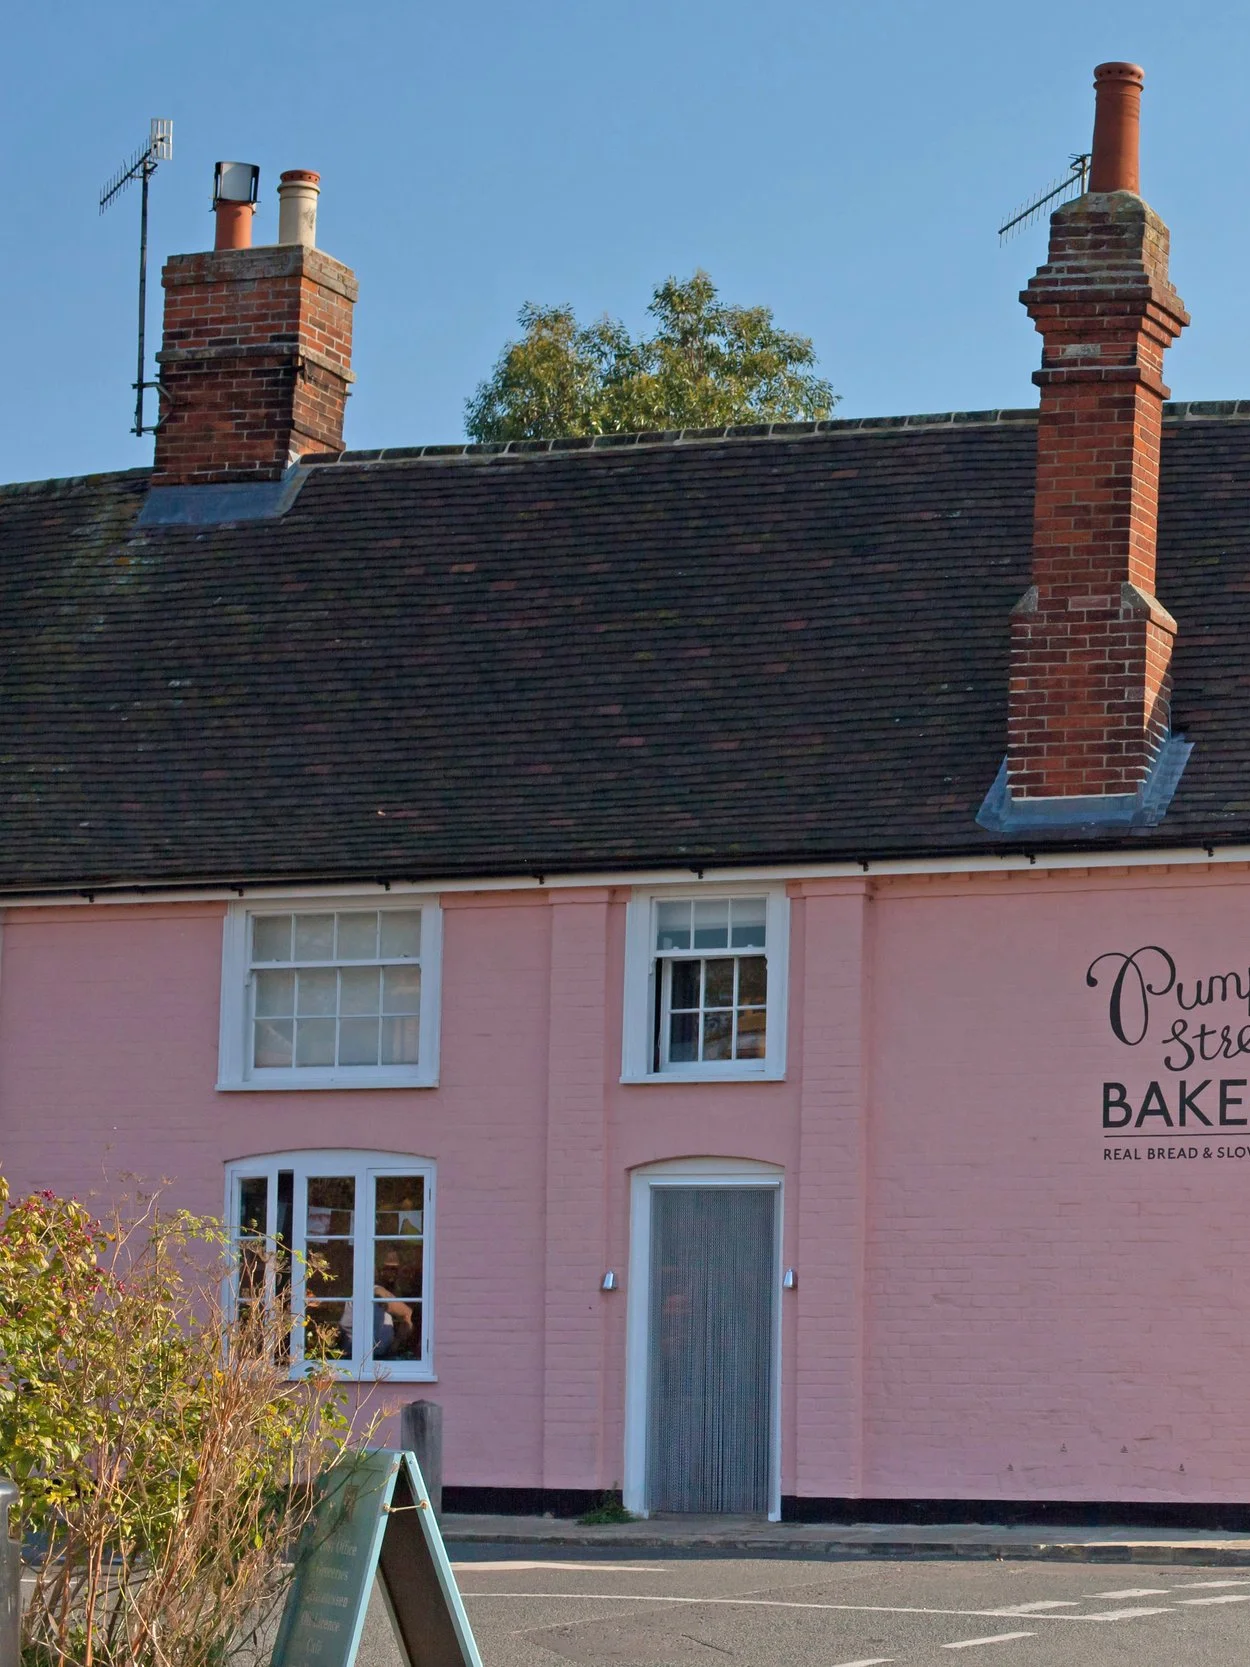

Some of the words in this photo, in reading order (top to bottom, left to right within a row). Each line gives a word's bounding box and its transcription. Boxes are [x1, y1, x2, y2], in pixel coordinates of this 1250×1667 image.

[1103, 1148, 1142, 1161] REAL
[1147, 1147, 1199, 1160] BREAD
[1202, 1147, 1213, 1159] &
